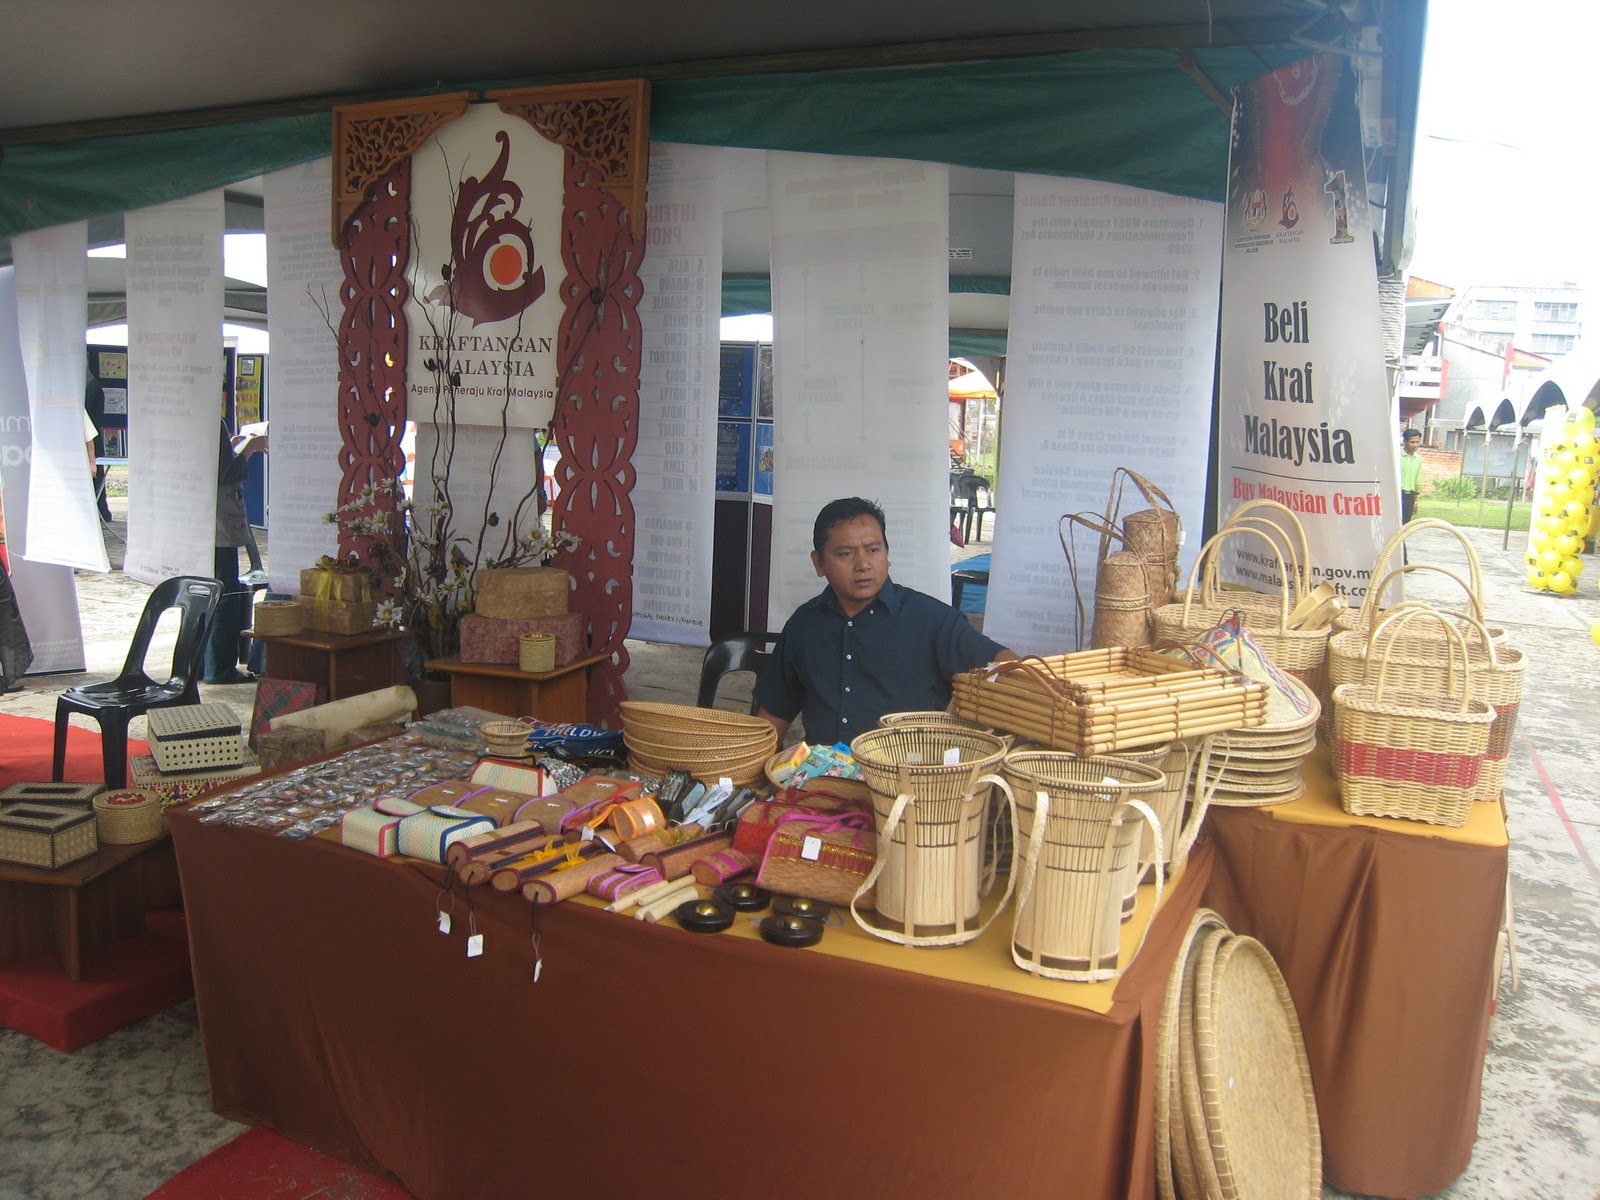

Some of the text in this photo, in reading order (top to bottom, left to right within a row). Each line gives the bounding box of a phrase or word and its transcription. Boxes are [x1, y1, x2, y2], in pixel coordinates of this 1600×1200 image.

[1263, 301, 1309, 343] Beli
[418, 335, 553, 353] KRAFTANGAN
[435, 358, 536, 376] MALAYSIA
[1263, 361, 1314, 404] Kraf
[411, 384, 440, 394] Agens
[487, 386, 508, 397] Kraf
[509, 388, 554, 399] Malaysia
[1244, 414, 1355, 467] Malaysia
[1232, 477, 1382, 516] Buy Malaysian Craft
